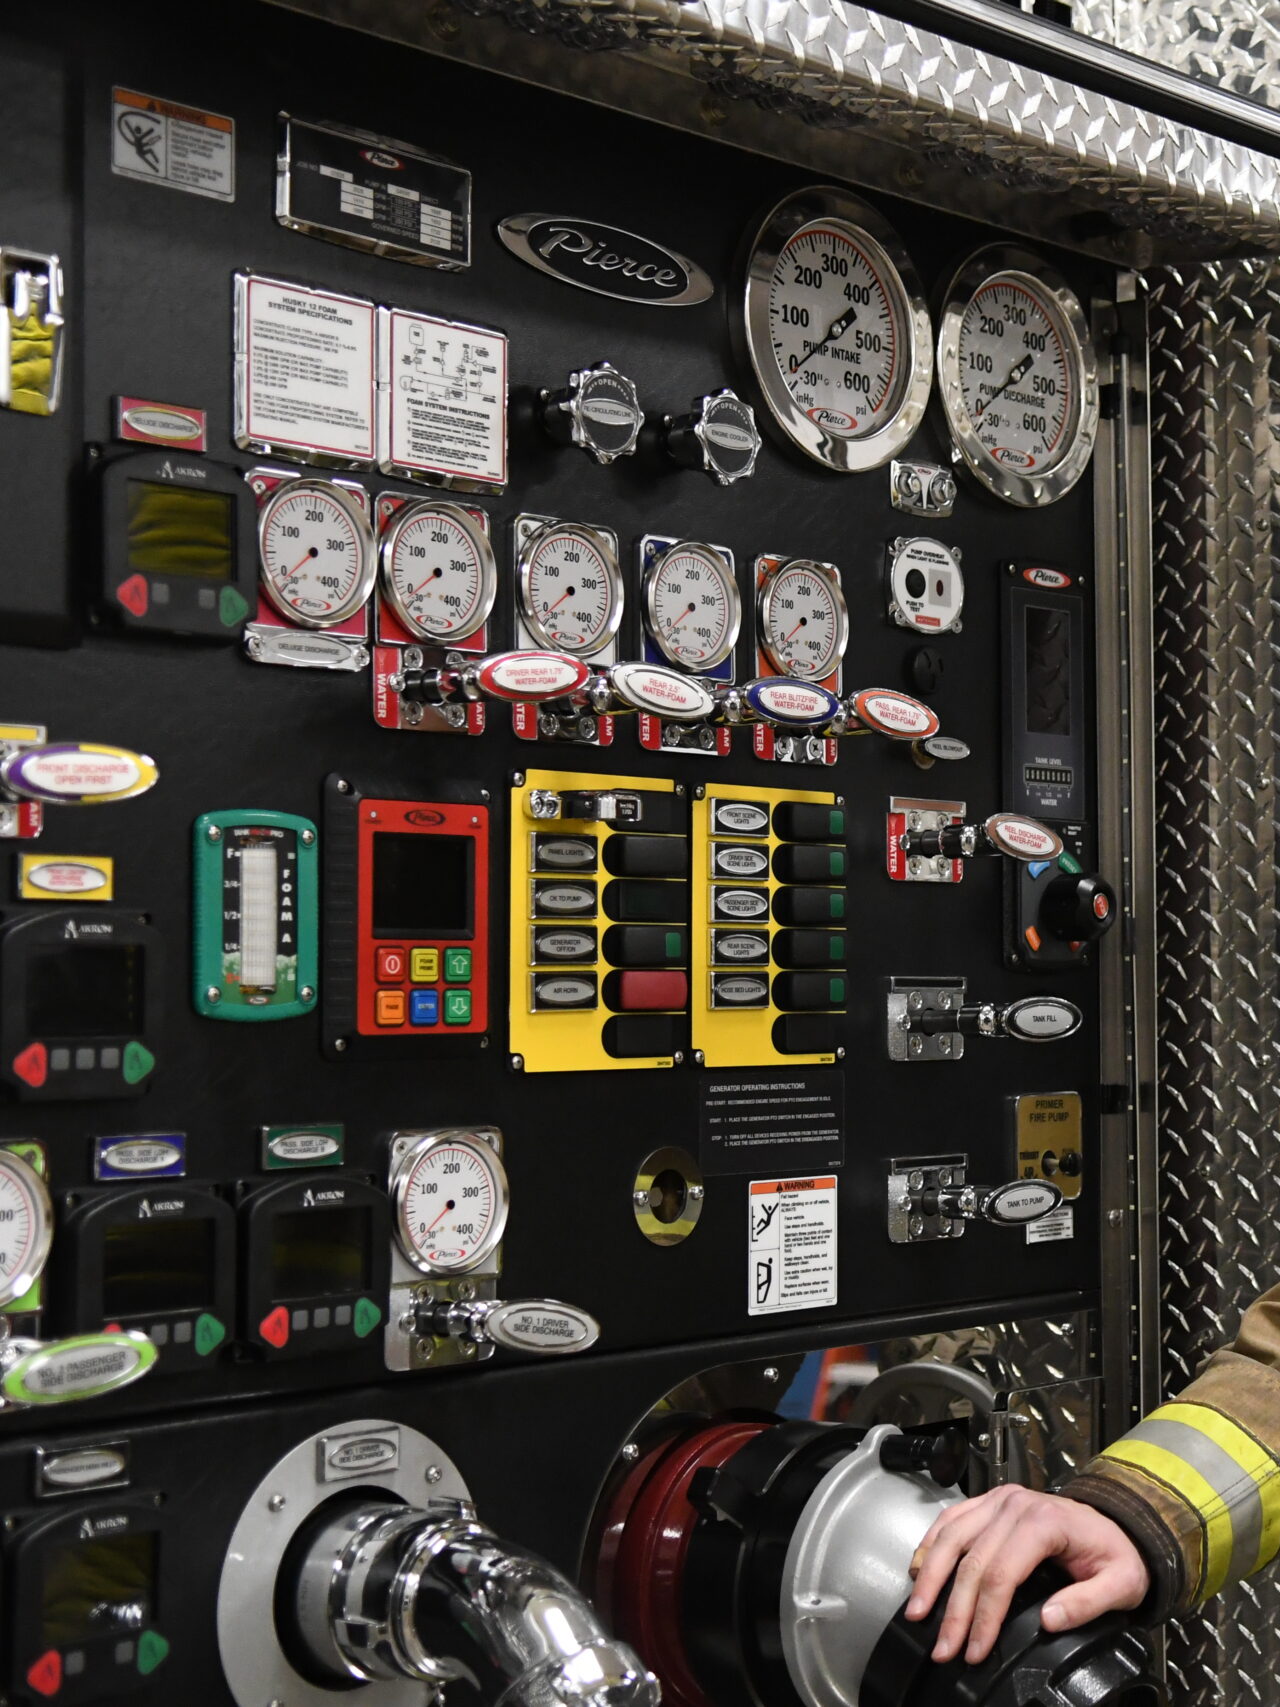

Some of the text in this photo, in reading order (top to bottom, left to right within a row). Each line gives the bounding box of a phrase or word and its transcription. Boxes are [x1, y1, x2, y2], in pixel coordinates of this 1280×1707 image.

[539, 227, 678, 288] Pierce
[821, 253, 848, 277] 300
[794, 265, 822, 289] 200
[843, 282, 870, 306] 400
[282, 297, 307, 308] HUSKY
[318, 304, 338, 315] FOAM
[268, 302, 353, 326] SYSTEM SPECIFICATIONS
[781, 304, 809, 328] 100
[1003, 304, 1026, 326] 300
[980, 316, 1004, 337] 200
[855, 330, 881, 353] 500
[1022, 331, 1045, 352] 400
[803, 340, 861, 365] PUMP INTAKE
[969, 352, 993, 373] 100
[599, 378, 617, 388] OPEN
[844, 371, 870, 394] 600
[1033, 375, 1055, 395] 500
[979, 383, 1045, 409] PUMP DISCHARGE
[406, 397, 490, 420] FOAM SYSTEM INSTRUCTIONS
[720, 402, 738, 413] OPEN
[855, 404, 867, 416] psi
[817, 410, 846, 426] Pierce
[1022, 412, 1046, 433] 600
[711, 429, 749, 443] ENGINE COOLER
[1000, 450, 1025, 465] Pierce
[175, 466, 206, 479] AKRON
[305, 509, 324, 523] 200
[282, 526, 299, 538] 100
[430, 531, 449, 544] 200
[326, 538, 344, 552] 300
[409, 545, 426, 558] 100
[564, 551, 580, 563] 200
[450, 560, 466, 572] 300
[544, 565, 559, 577] 100
[685, 569, 700, 581] 200
[1034, 570, 1060, 584] Pierce
[320, 576, 340, 588] 400
[581, 578, 597, 589] 300
[667, 583, 681, 594] 100
[797, 585, 811, 596] 200
[300, 598, 323, 609] Pierce
[443, 595, 461, 607] 400
[701, 595, 715, 606] 300
[781, 599, 794, 609] 100
[576, 612, 592, 623] 400
[812, 610, 825, 620] 300
[424, 616, 444, 627] Pierce
[559, 633, 577, 642] Pierce
[696, 627, 711, 639] 400
[680, 647, 698, 656] Pierce
[808, 641, 821, 651] 400
[793, 660, 809, 669] Pierce
[506, 669, 529, 677] DRIVER
[530, 668, 548, 676] REAR
[515, 677, 557, 685] WATER-FOAM
[649, 678, 668, 690] REAR
[377, 673, 387, 718] WATER
[642, 685, 687, 704] WATER-FOAM
[770, 691, 818, 704] REAR BLITZFIRE
[774, 700, 815, 712] WATER-FOAM
[892, 706, 907, 716] REAR
[880, 710, 917, 726] WATER-FOAM
[1035, 756, 1048, 764] TANK
[37, 764, 129, 773] FRONT DISCHARGE
[54, 775, 113, 785] OPEN FIRST
[1004, 824, 1047, 843] REEL DISCHARGE
[1008, 833, 1042, 849] WATER-FOAM
[78, 924, 112, 935] AKRON
[1032, 1015, 1045, 1023] TANK
[709, 1082, 805, 1093] GENERATOR OPERATING INSTRUCTIONS
[1035, 1099, 1063, 1109] PRIMER
[1029, 1112, 1069, 1123] FIRE PUMP
[443, 1163, 460, 1174] 200
[421, 1183, 438, 1194] 100
[783, 1180, 815, 1190] WARNING
[316, 1190, 345, 1200] AKRON
[462, 1187, 479, 1198] 300
[152, 1200, 184, 1211] AKRON
[1007, 1196, 1044, 1208] TANK TO PUMP
[456, 1223, 473, 1235] 400
[437, 1250, 457, 1260] Pierce
[522, 1316, 533, 1325] NO.
[542, 1317, 569, 1329] DRIVER
[513, 1324, 574, 1338] SIDE DISCHARGE
[66, 1351, 126, 1374] PASSENGER
[41, 1362, 125, 1388] SIDE DISCHARGE
